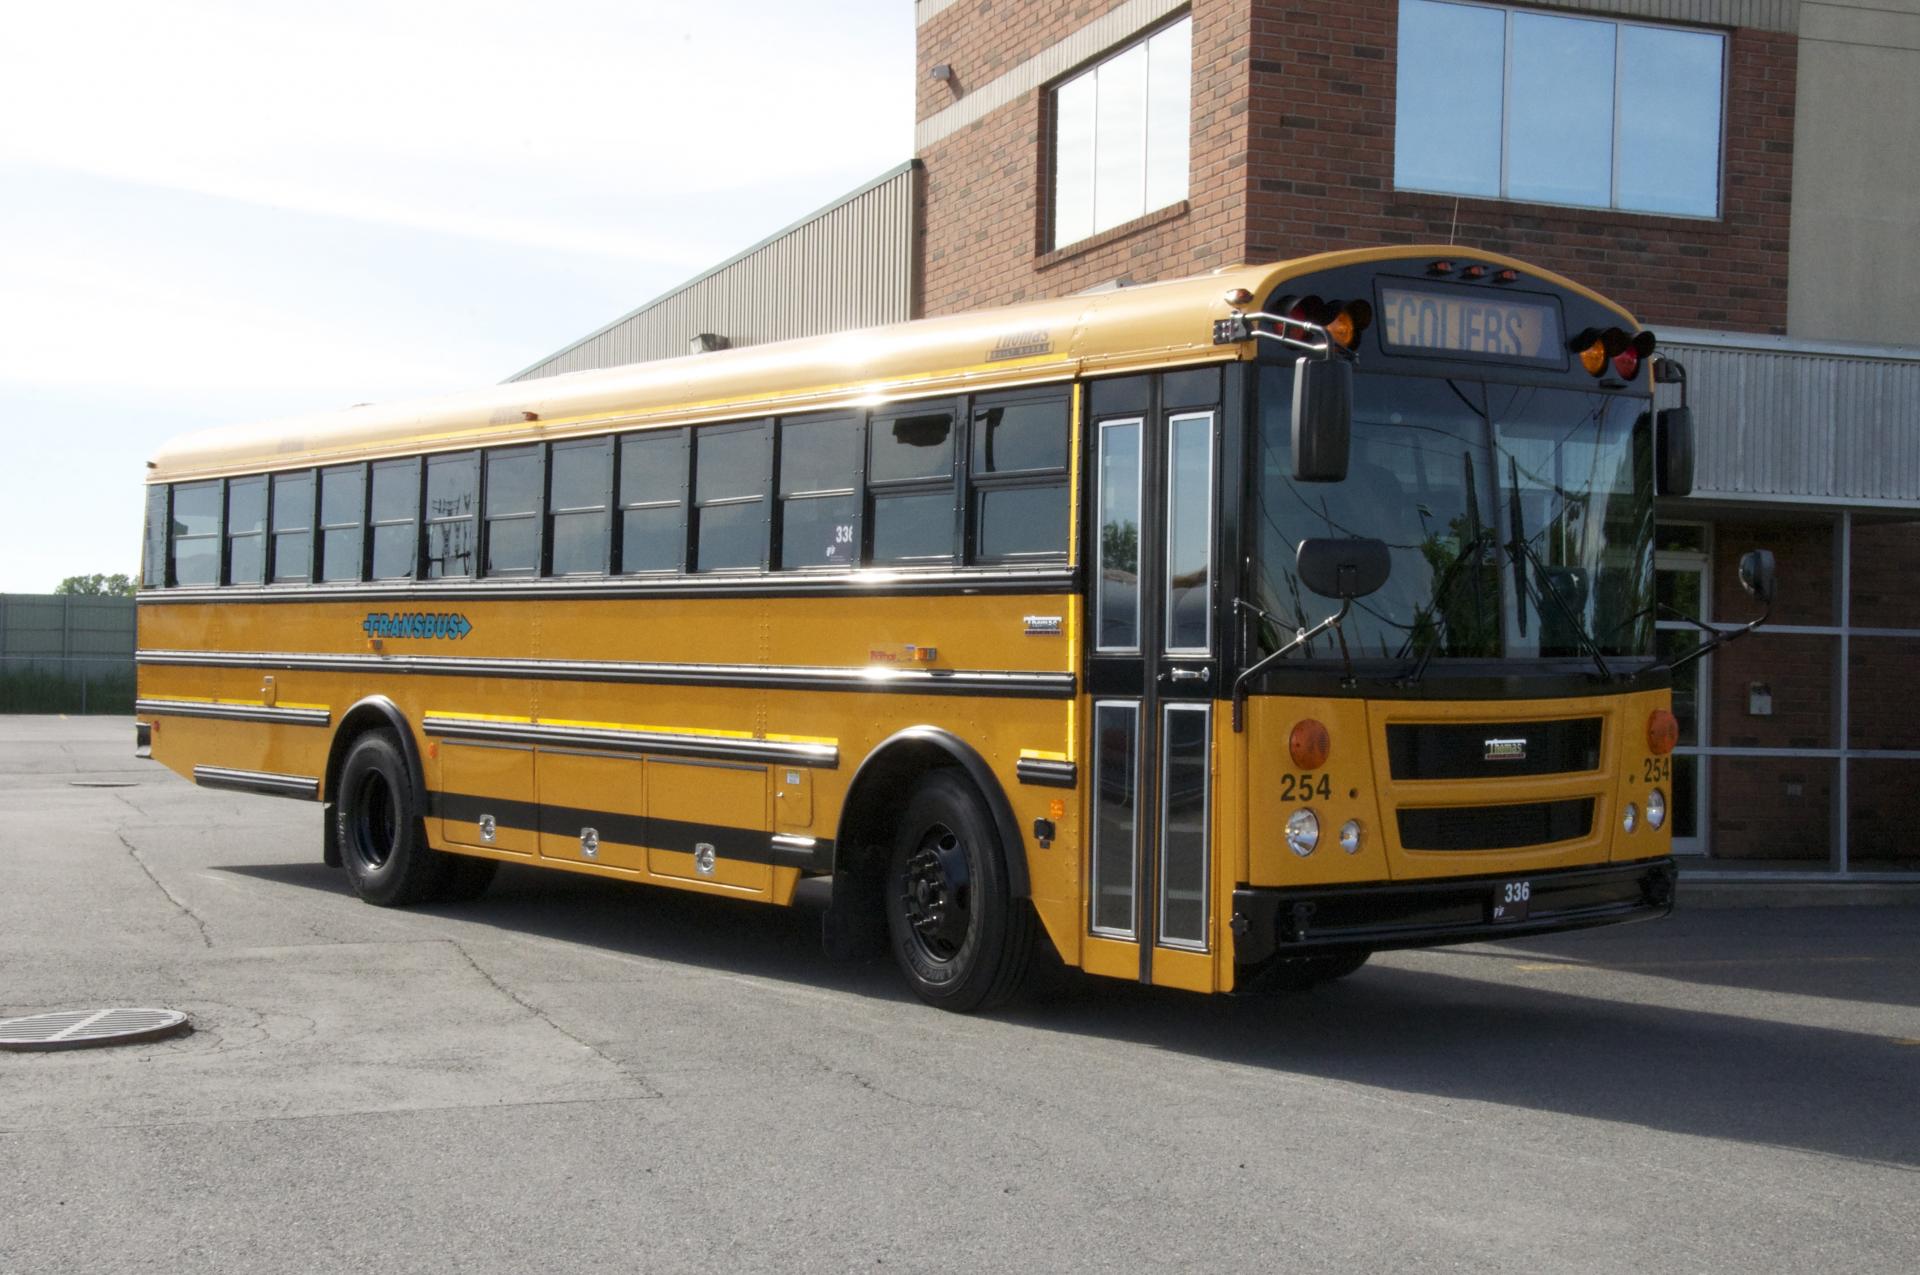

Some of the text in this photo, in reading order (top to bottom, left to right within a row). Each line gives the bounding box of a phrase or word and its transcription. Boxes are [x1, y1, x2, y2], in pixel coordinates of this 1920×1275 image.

[366, 612, 460, 640] TRANSBUS
[1644, 757, 1669, 782] 254
[1280, 773, 1332, 802] 254
[1504, 881, 1530, 903] 336
